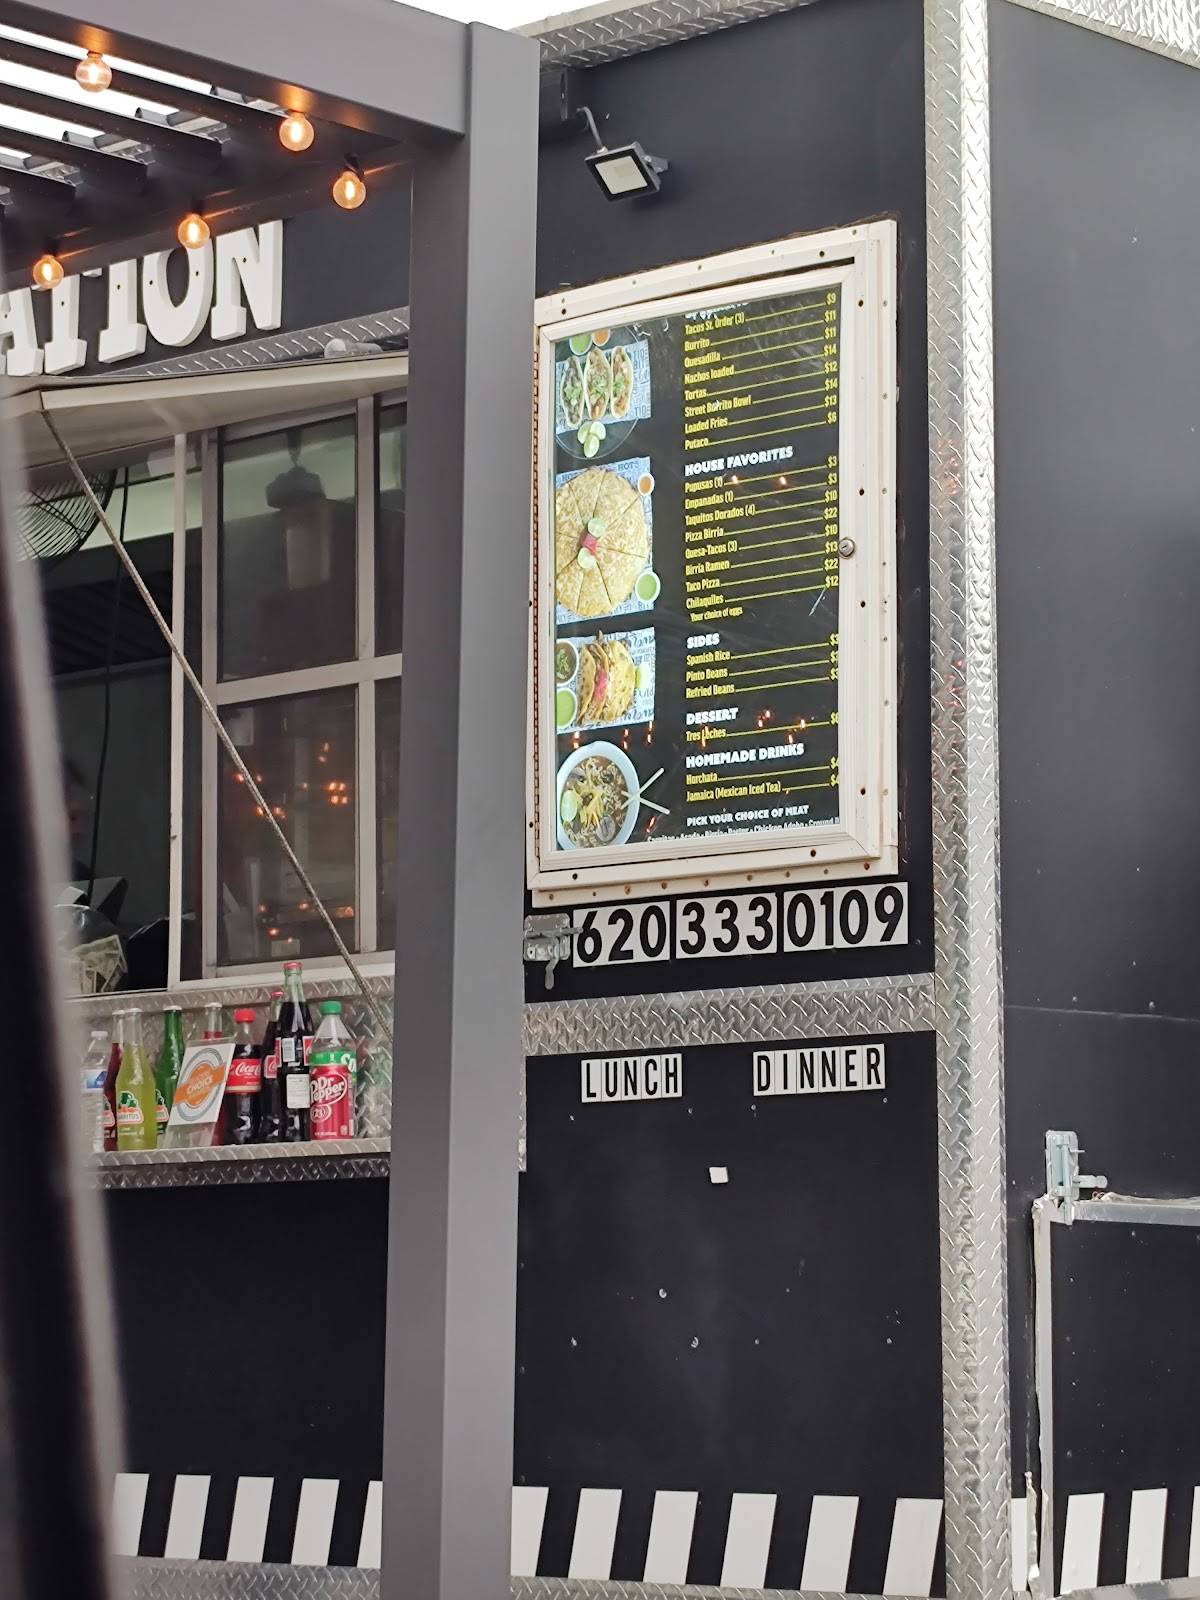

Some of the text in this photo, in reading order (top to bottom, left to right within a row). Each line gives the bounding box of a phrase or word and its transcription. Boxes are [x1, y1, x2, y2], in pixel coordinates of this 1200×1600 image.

[684, 310, 836, 351] Burrito $11
[685, 323, 704, 335] Tacos
[714, 315, 734, 329] Order
[734, 312, 745, 325] (3)
[826, 293, 836, 305] $9
[684, 328, 837, 368] Quesadilla $11
[684, 345, 837, 385] Nachos loaded $14
[685, 362, 837, 401] Tortas $12
[685, 379, 838, 417] Street Burrito Bowl $14
[685, 395, 837, 434] Loaded Fries $13
[684, 438, 709, 450] Putaco
[685, 446, 793, 476] HOUSE FAVORITES
[685, 479, 713, 493] Pupusas
[828, 456, 837, 467] $3
[685, 474, 838, 510] Empanadas (1) $3
[685, 491, 838, 526] Taquitos Dorados (4) $10
[685, 508, 838, 542] Pizza Birria $22
[686, 525, 838, 559] Quesa-Tacos (3) $10
[686, 542, 838, 575] Birria Ramen $13
[686, 559, 838, 593] Taco Pizza $22
[686, 576, 838, 609] Chilaquiles $12
[690, 611, 703, 623] Your
[704, 608, 722, 620] choice
[723, 608, 728, 617] of
[686, 633, 720, 649] SIDES
[686, 652, 714, 666] Spanish
[714, 650, 731, 661] Rice
[686, 671, 705, 682] Pinto
[706, 667, 728, 679] Beans
[686, 687, 712, 698] Refried
[713, 684, 735, 695] Beans
[686, 707, 738, 725] DESSERT
[686, 730, 701, 742] Tres
[702, 728, 726, 740] Leches
[686, 743, 805, 769] HOMEMADE DRINKS
[686, 772, 718, 786] Horchata
[686, 788, 715, 802] Jamaica
[715, 785, 748, 800] (Mexican
[749, 784, 765, 795] Iced
[766, 781, 781, 793] Tea)
[686, 805, 809, 827] PICK YOUR CHOICE OF MEAT
[576, 885, 905, 964] 620 333 0109
[317, 1076, 335, 1090] Dr
[586, 1055, 679, 1099] LUNCH
[756, 1047, 882, 1093] DINNER
[310, 1081, 344, 1104] Pepper
